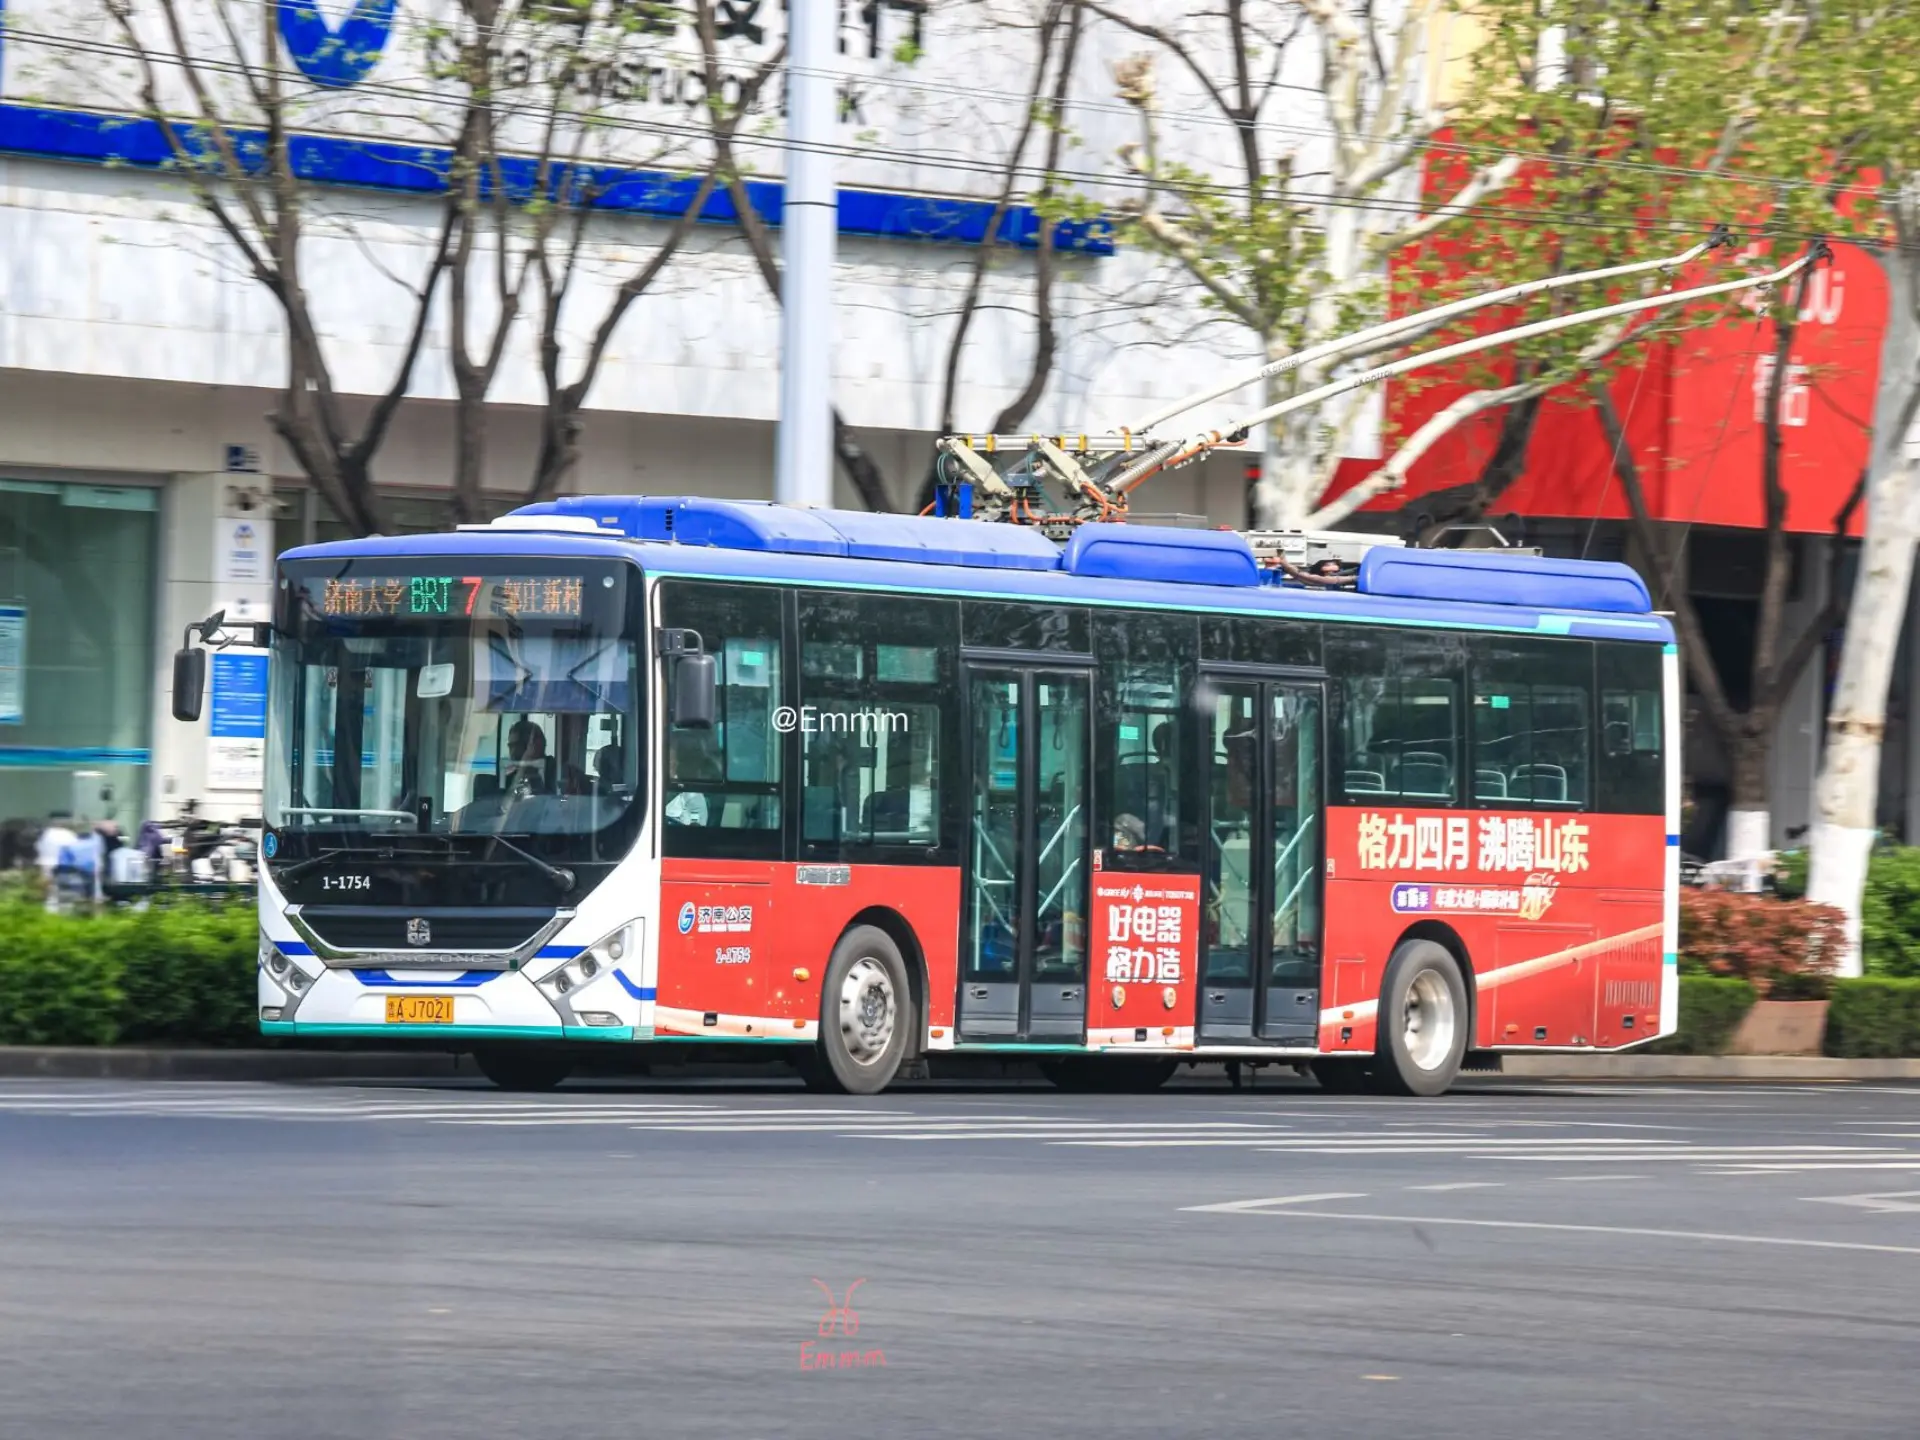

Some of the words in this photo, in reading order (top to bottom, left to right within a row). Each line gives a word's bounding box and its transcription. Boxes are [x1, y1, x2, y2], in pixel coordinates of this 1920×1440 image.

[411, 576, 452, 613] BRT
[462, 576, 482, 615] 7
[1357, 812, 1469, 871] 格力四月
[1478, 815, 1590, 874] 沸腾山东
[322, 875, 371, 890] 1-1754
[698, 905, 752, 924] 济南公交
[1108, 904, 1182, 943] 好电器
[716, 946, 751, 964] 1-1754
[1106, 945, 1181, 984] 格力造
